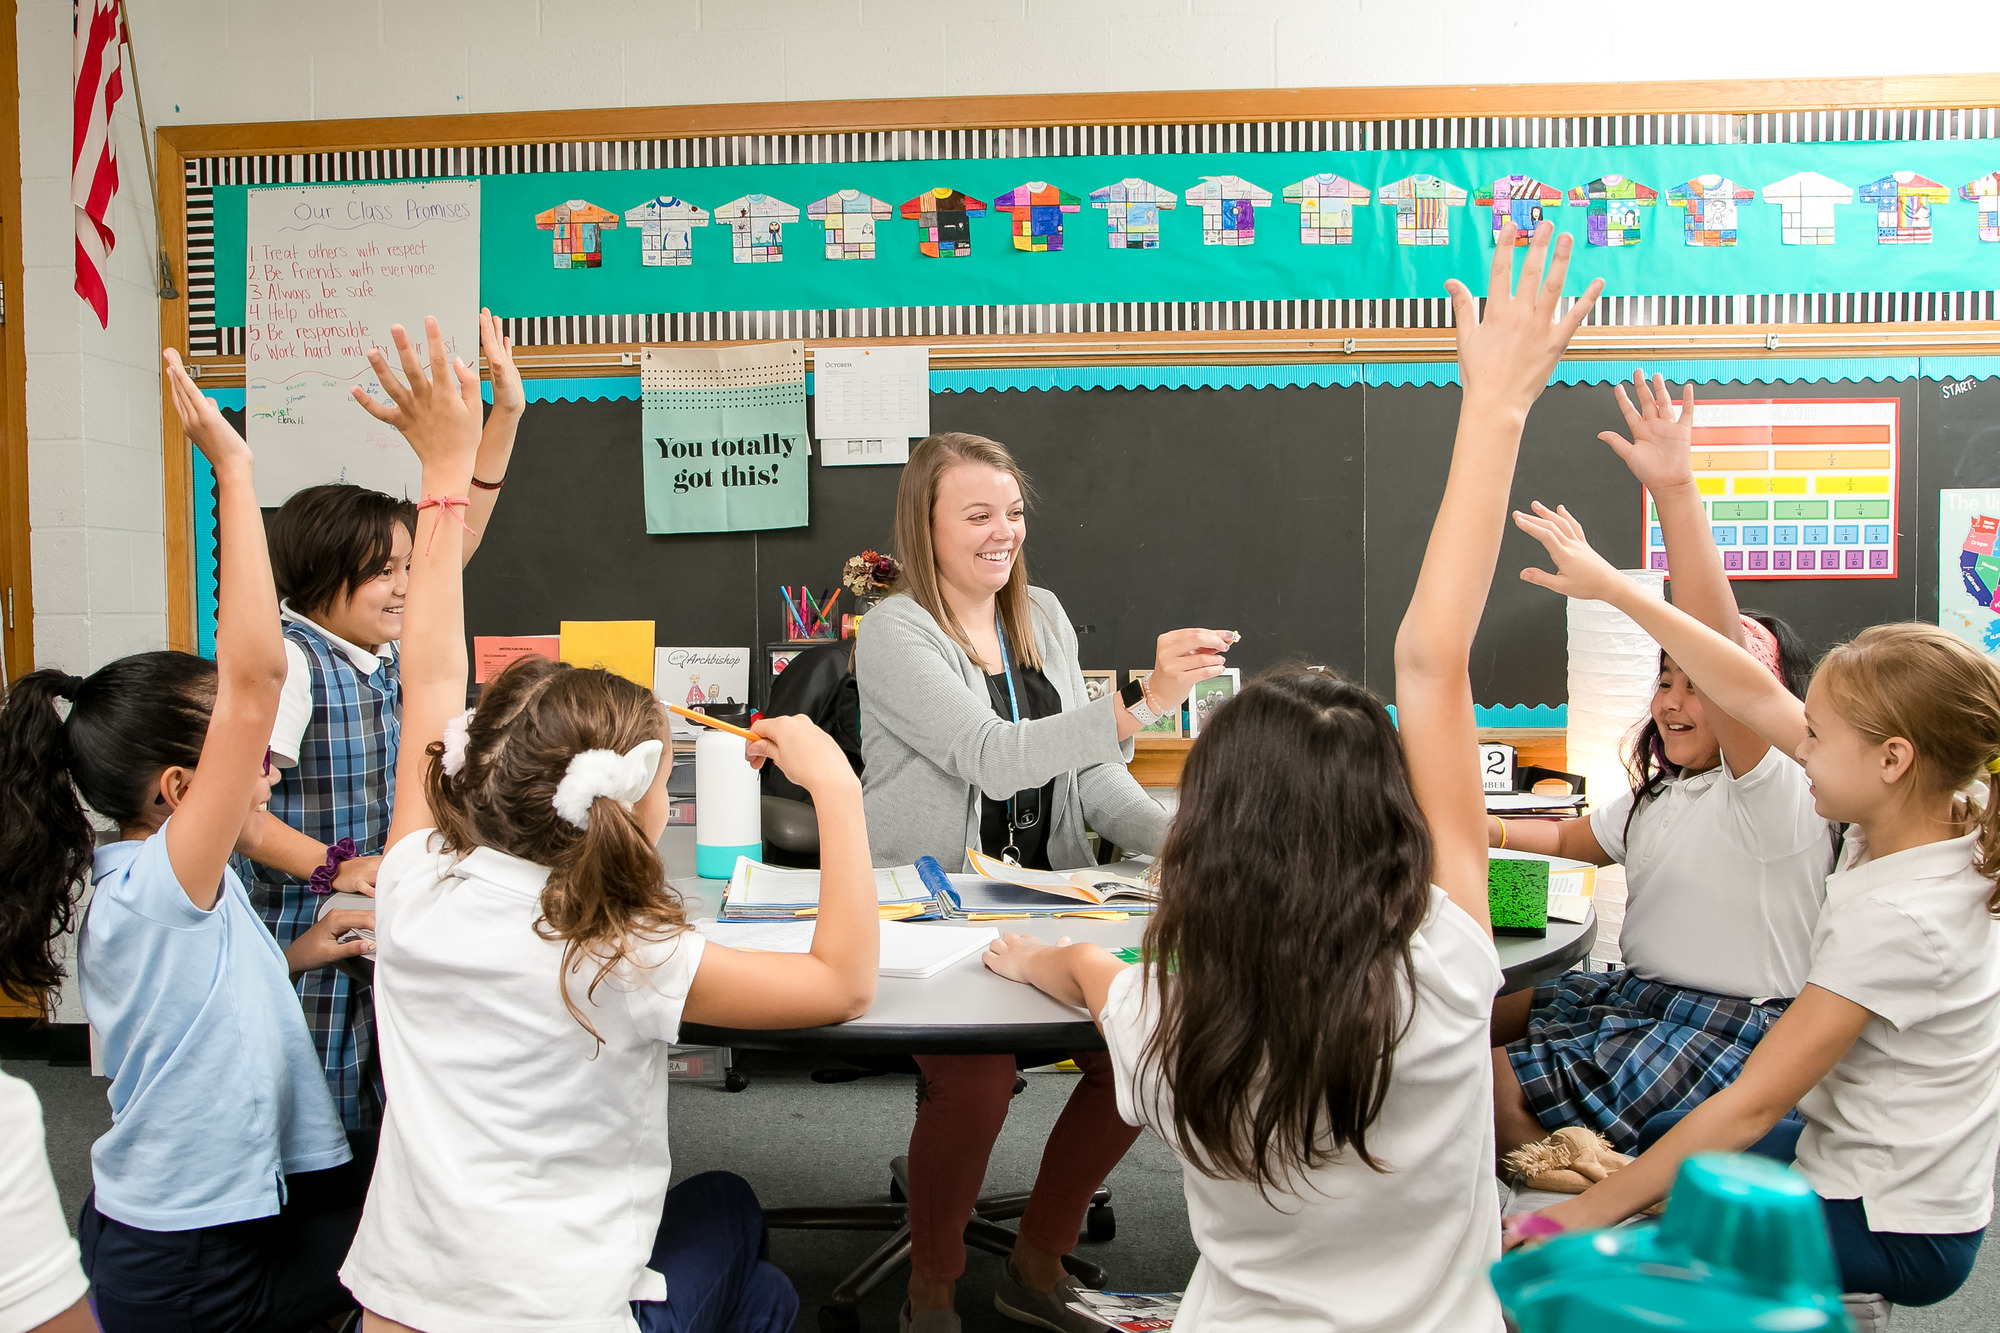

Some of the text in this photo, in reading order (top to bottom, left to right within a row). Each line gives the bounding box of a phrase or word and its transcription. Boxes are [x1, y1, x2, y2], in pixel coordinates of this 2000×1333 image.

[293, 198, 471, 221] Our Class Promises
[262, 244, 298, 260] Treat
[308, 242, 348, 260] others
[356, 240, 380, 258] with
[386, 238, 427, 259] respect
[264, 264, 284, 282] Be
[291, 261, 343, 281] friends
[349, 260, 374, 278] with
[381, 262, 437, 279] everyone
[268, 281, 311, 304] Always
[321, 281, 337, 299] be
[346, 279, 377, 299] safe
[268, 303, 298, 324] Help
[308, 300, 347, 320] others
[267, 322, 285, 341] Be
[296, 320, 371, 343] responsible
[266, 343, 298, 361] Work
[303, 340, 332, 363] hard
[340, 340, 363, 357] and
[1942, 379, 1977, 399] START:
[654, 437, 702, 459] You
[711, 433, 797, 458] totally
[673, 463, 779, 494] got this!
[1948, 493, 1979, 511] The
[687, 653, 740, 668] Archbishop
[1487, 751, 1505, 775] 2
